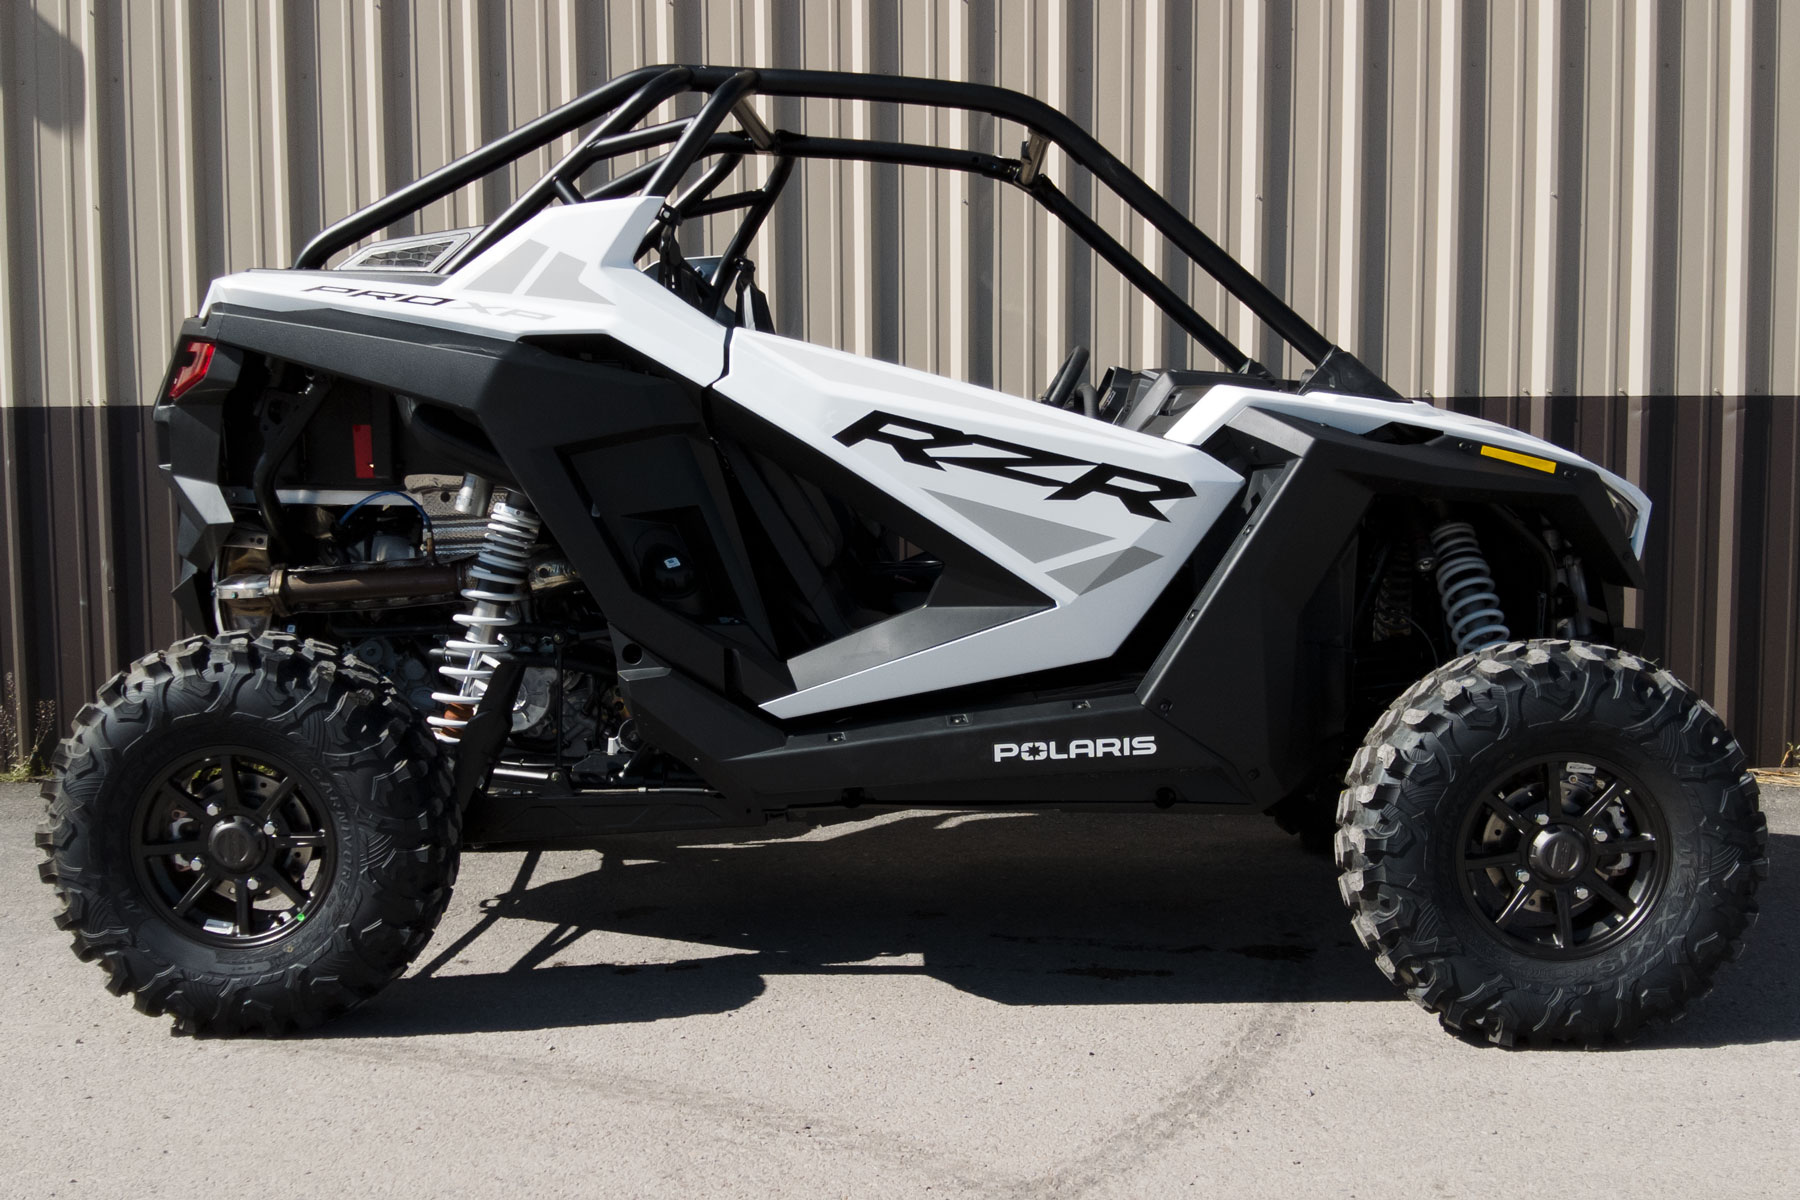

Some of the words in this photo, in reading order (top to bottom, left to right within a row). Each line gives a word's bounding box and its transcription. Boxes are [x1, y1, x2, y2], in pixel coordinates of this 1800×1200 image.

[302, 286, 456, 306] PRO
[449, 302, 555, 320] XP
[832, 410, 1197, 523] RZR
[994, 736, 1157, 762] POLARIS
